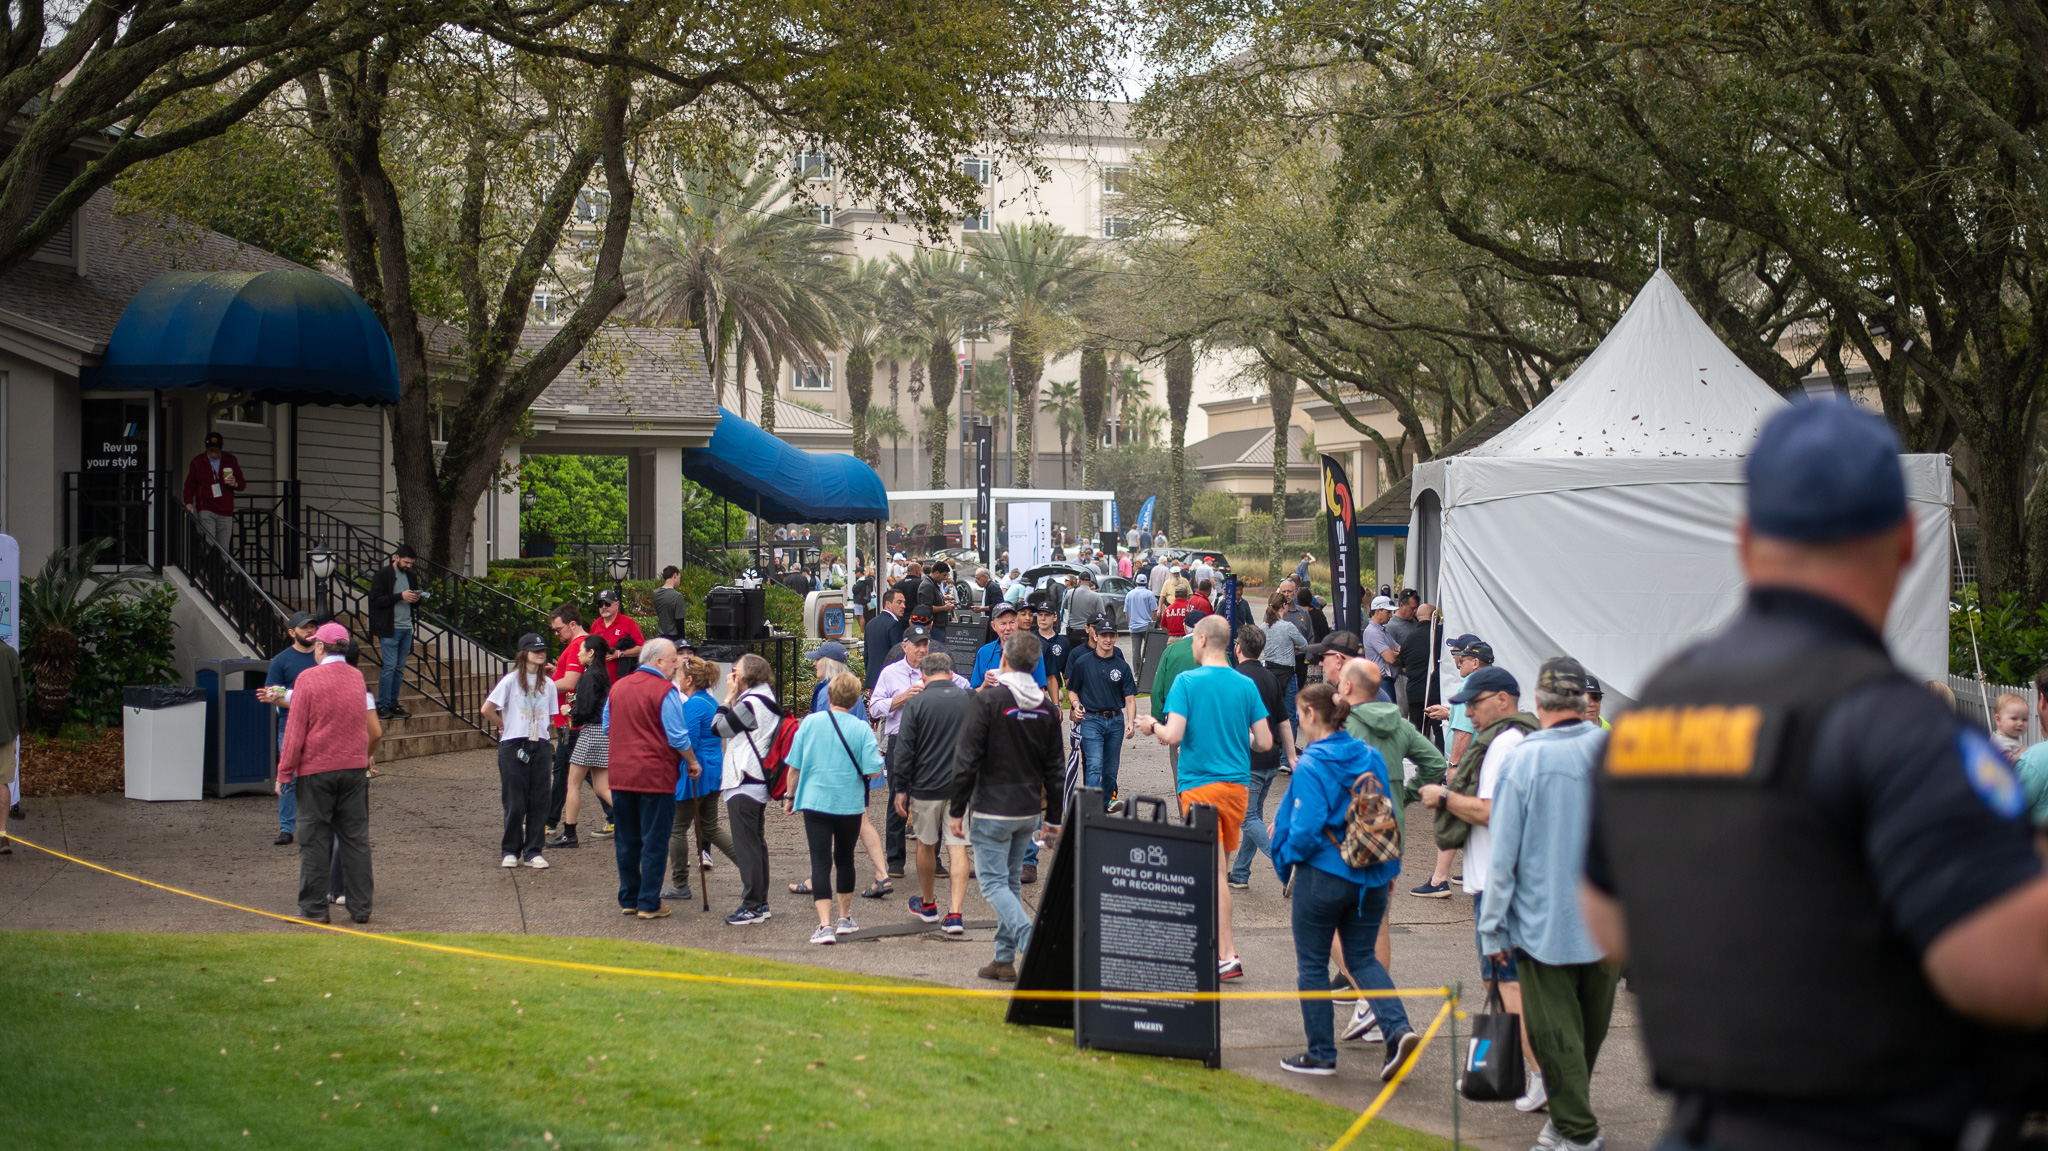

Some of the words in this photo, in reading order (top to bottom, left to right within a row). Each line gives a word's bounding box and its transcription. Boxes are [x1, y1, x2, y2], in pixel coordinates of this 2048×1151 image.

[103, 442, 122, 453] Rev
[124, 444, 138, 454] up
[87, 459, 110, 470] your
[112, 456, 138, 469] style
[1101, 865, 1137, 878] NOTICE
[1139, 869, 1153, 879] OF
[1155, 872, 1195, 885] FILMING
[1112, 877, 1126, 887] OR
[1129, 880, 1185, 895] RECORDING
[1134, 1021, 1164, 1032] HAGERTY
